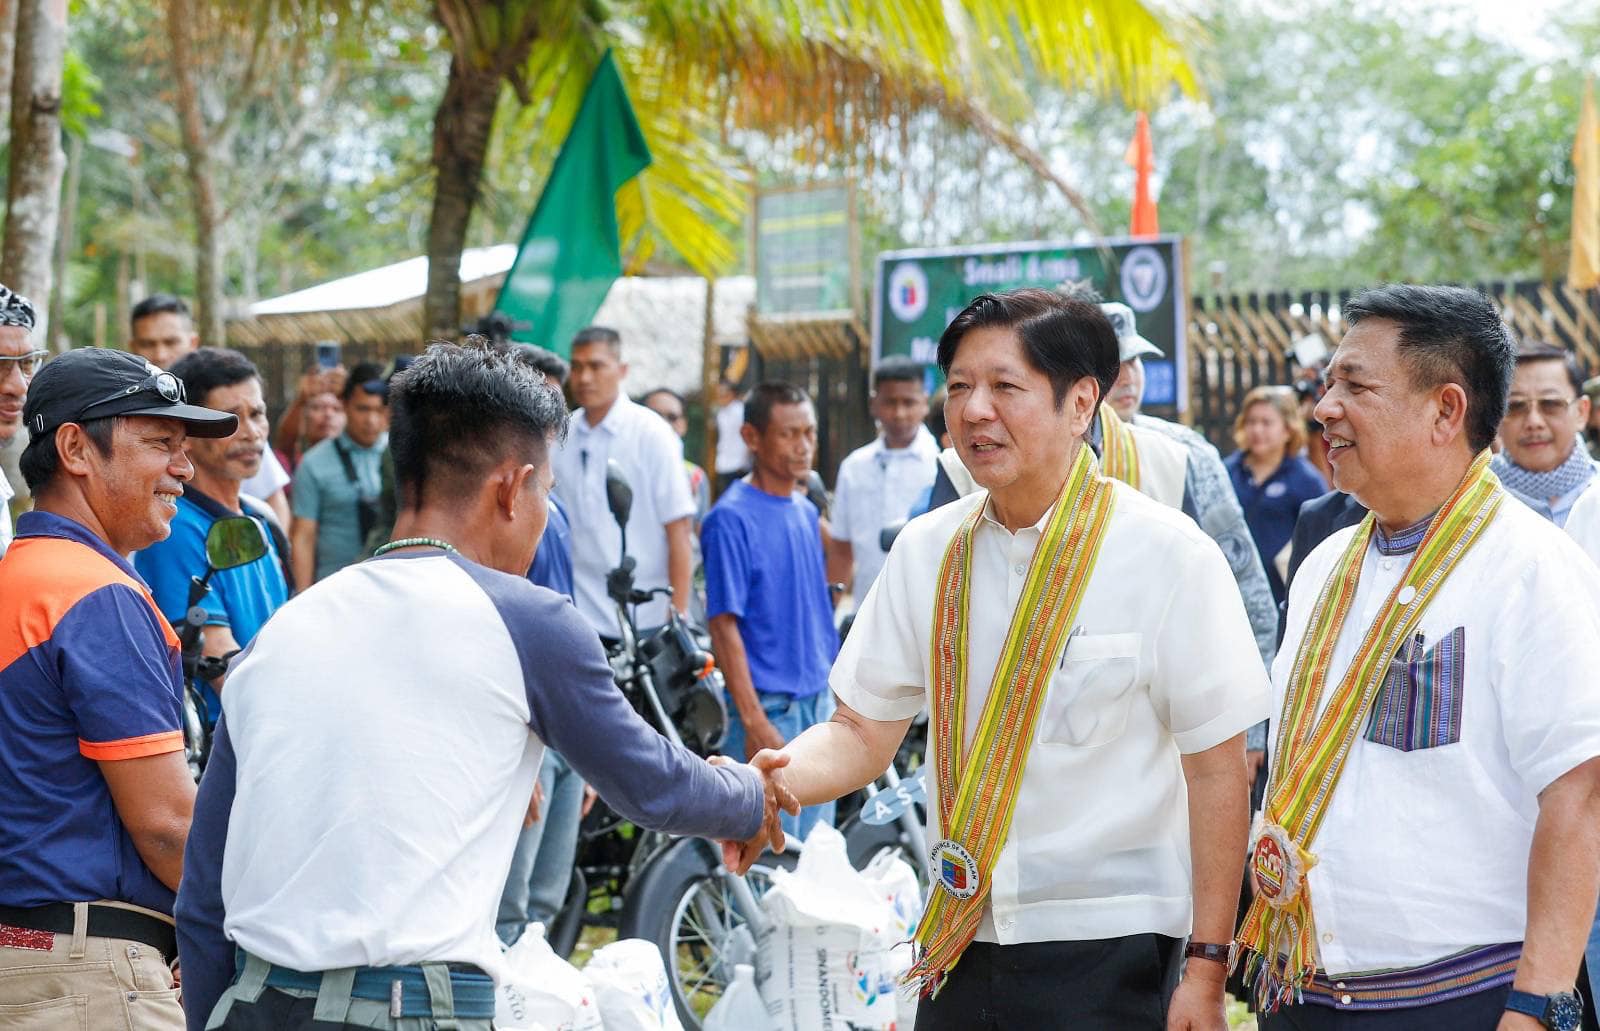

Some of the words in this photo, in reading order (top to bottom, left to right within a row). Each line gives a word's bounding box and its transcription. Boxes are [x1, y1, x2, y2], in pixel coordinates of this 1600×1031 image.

[963, 256, 1022, 286] Small
[952, 843, 960, 851] OF
[961, 850, 977, 880] BASILAN
[816, 948, 832, 1031] SINANDOME
